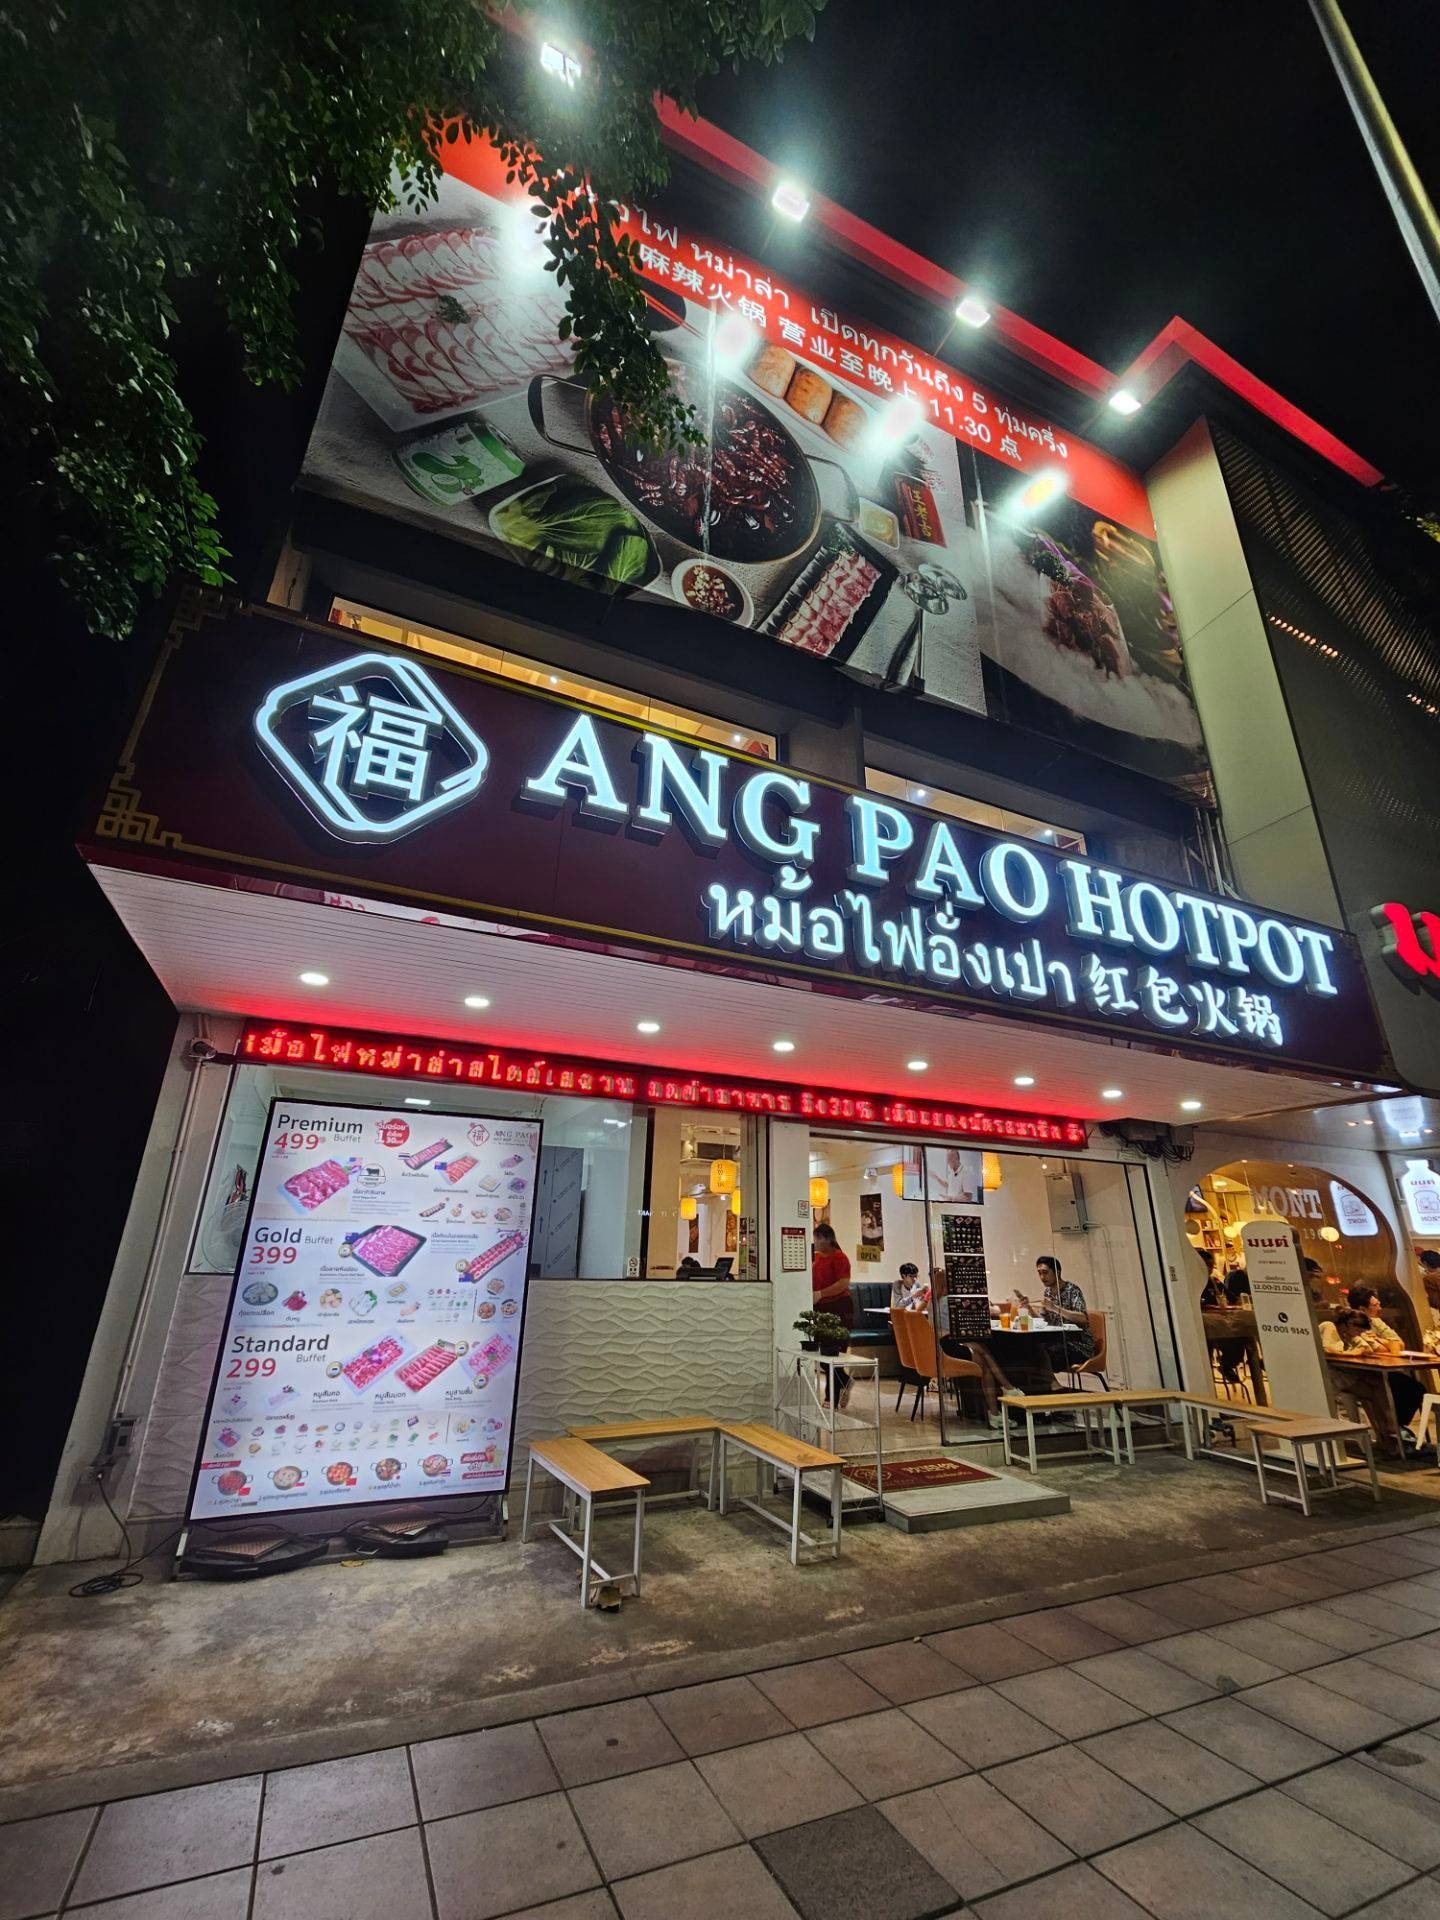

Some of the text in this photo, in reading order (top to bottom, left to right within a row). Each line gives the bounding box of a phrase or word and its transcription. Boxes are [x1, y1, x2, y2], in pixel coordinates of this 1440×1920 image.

[639, 242, 767, 328] 麻辣火锅
[929, 399, 992, 443] 11.30
[1000, 435, 1022, 461] 点
[691, 242, 789, 309] หม่าล่า
[811, 306, 964, 402] เปิดทุกวันถึง
[972, 391, 989, 414] 5
[994, 405, 1068, 458] ทุ่มครึ่ง
[307, 685, 444, 802] 福
[524, 714, 820, 862] ANG
[848, 796, 1050, 923] PAO
[1062, 860, 1336, 996] HOTPOT
[706, 866, 1286, 1047] หม้อไฟอั่งเปา 红包火锅
[277, 1114, 363, 1134] Premium
[274, 1132, 361, 1150] 499 Buffet
[1250, 1185, 1323, 1219] MONT
[255, 1227, 333, 1245] Gold Buffet
[250, 1246, 297, 1264] 399
[860, 1252, 878, 1260] OPEN
[1262, 1324, 1272, 1332] 02
[1273, 1325, 1289, 1334] 001
[232, 1334, 330, 1353] Standard
[226, 1358, 276, 1378] 299
[296, 1353, 326, 1363] Buffet
